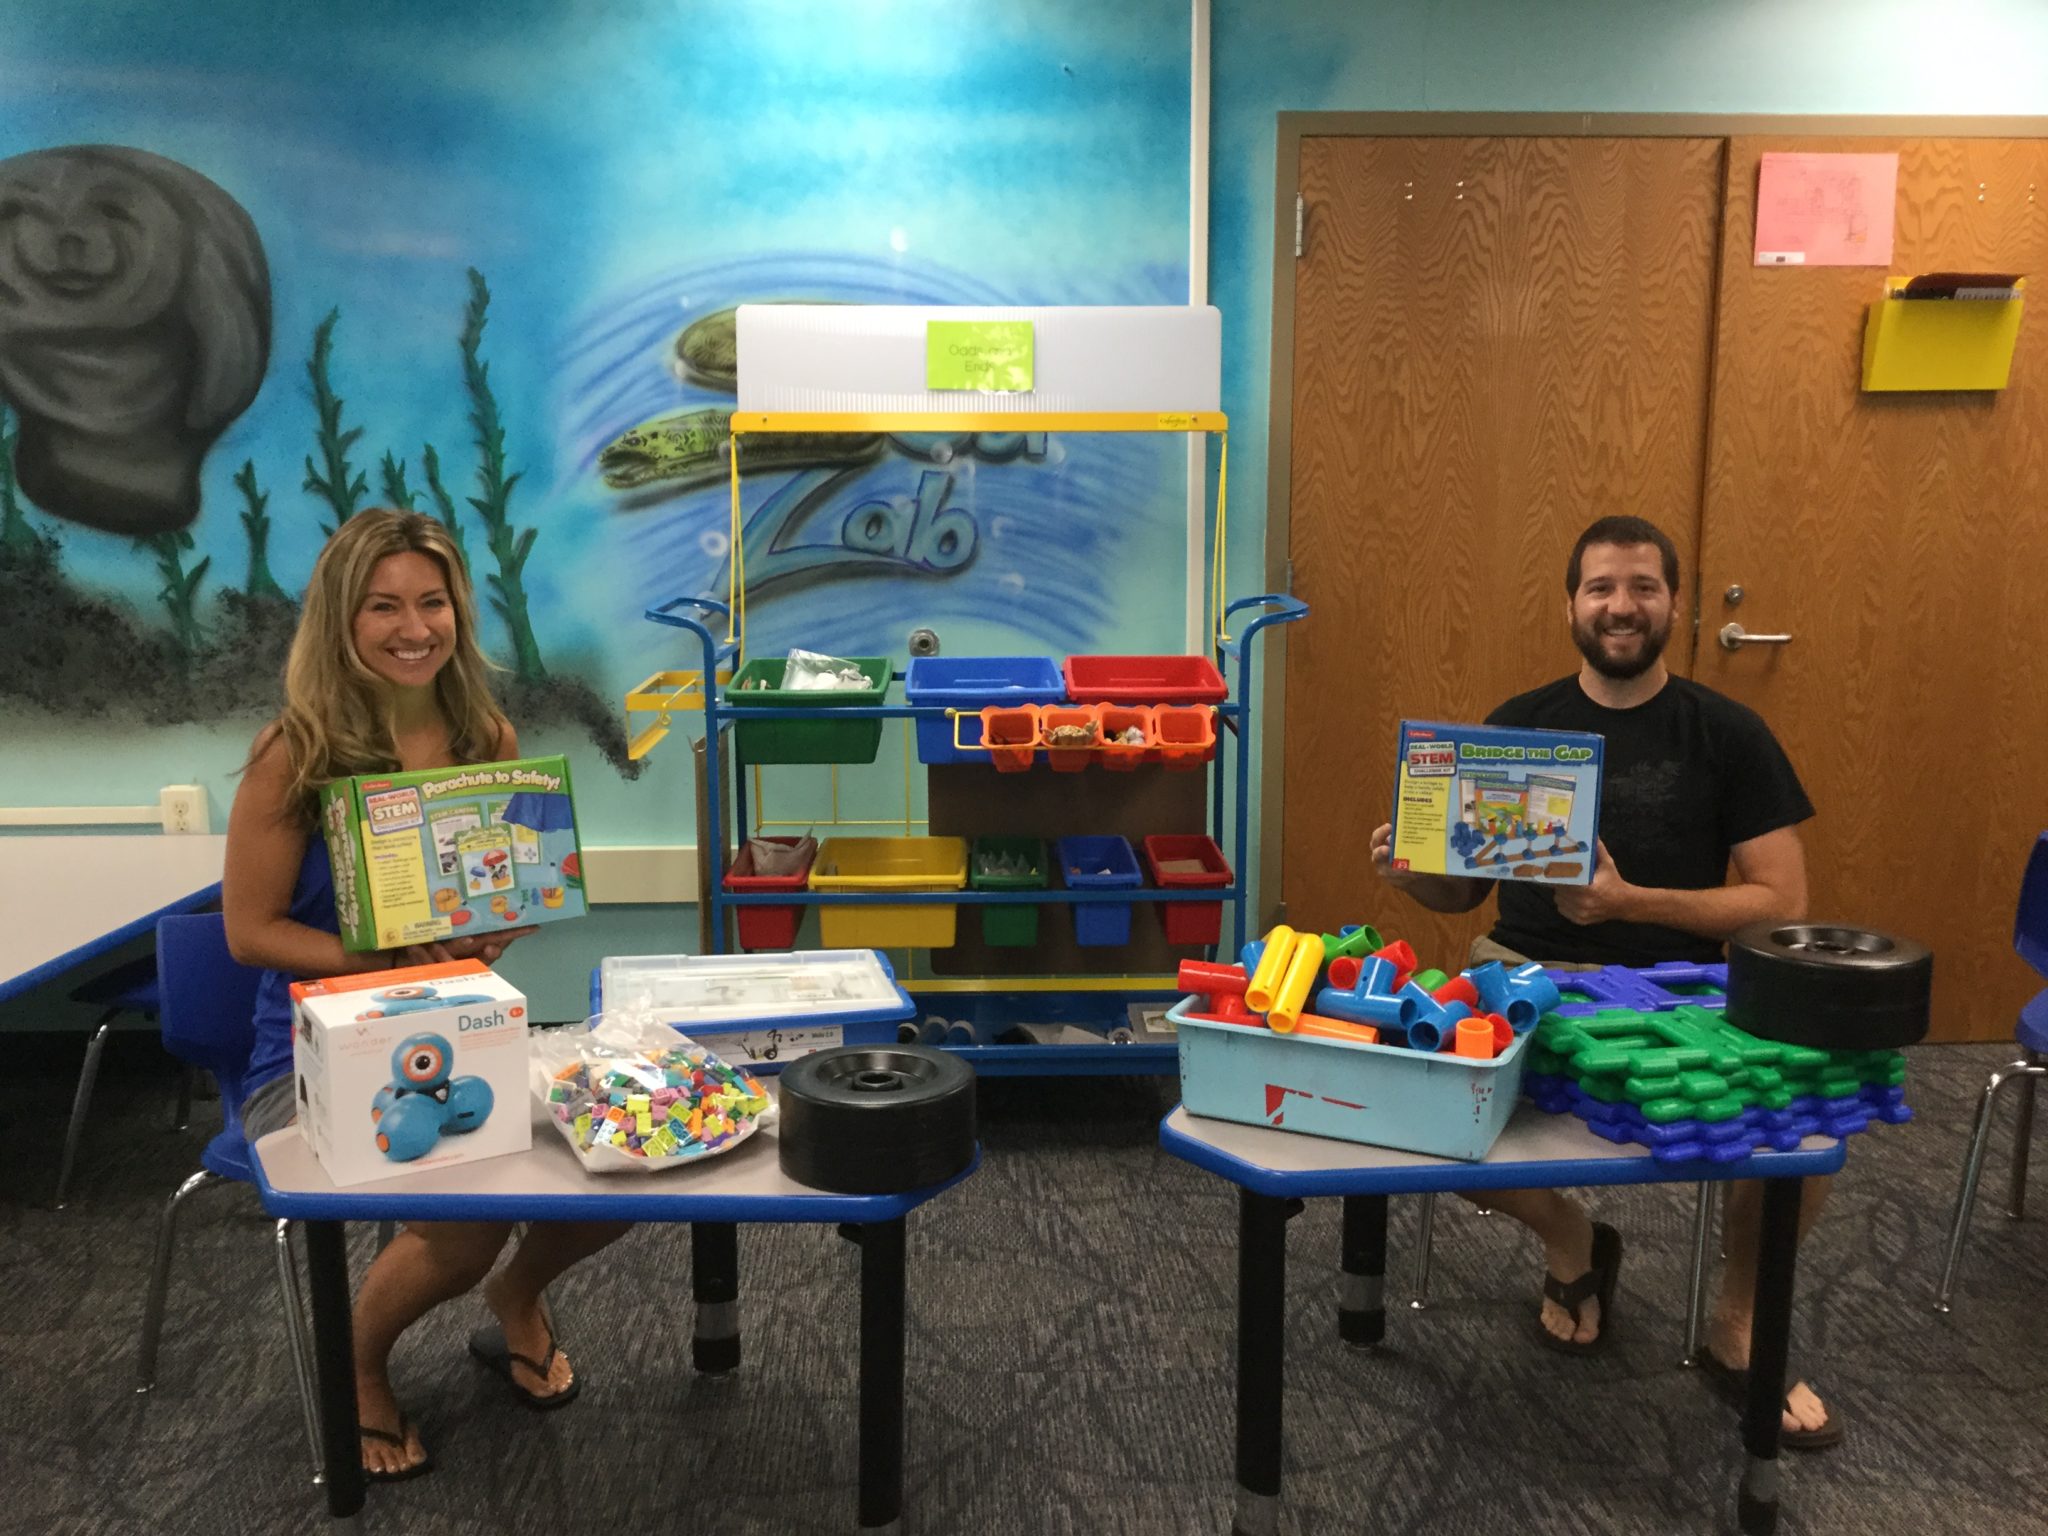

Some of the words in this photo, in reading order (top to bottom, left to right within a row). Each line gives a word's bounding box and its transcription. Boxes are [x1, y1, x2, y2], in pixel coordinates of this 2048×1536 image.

[1410, 752, 1454, 764] STEM
[421, 772, 493, 799] Parachute
[495, 770, 510, 783] to
[512, 769, 561, 791] Safety!
[372, 801, 418, 821] STEM
[458, 1010, 505, 1033] Dash
